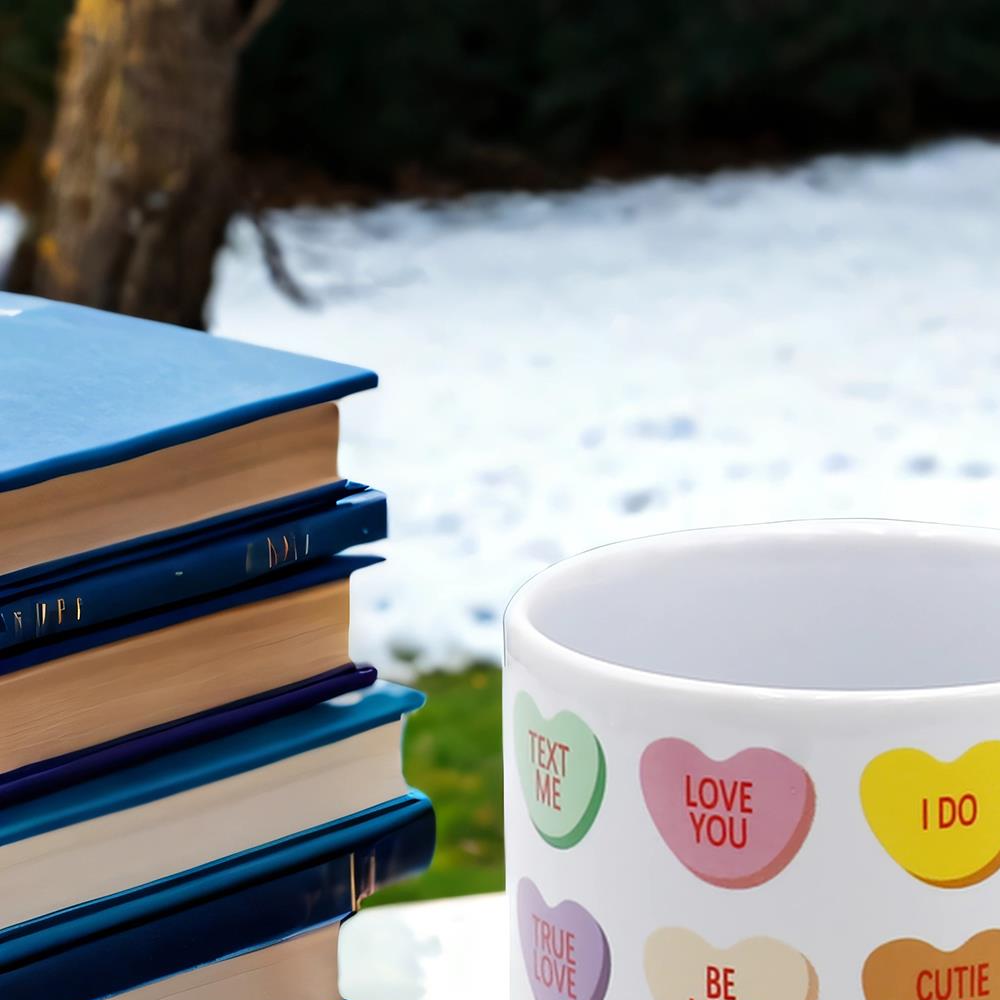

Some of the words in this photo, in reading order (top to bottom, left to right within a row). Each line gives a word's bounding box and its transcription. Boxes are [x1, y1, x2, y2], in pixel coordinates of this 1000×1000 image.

[528, 731, 569, 777] TEXT
[536, 769, 561, 811] ME
[685, 775, 753, 814] LOVE
[690, 812, 748, 849] YOU
[922, 798, 928, 830] I
[938, 793, 977, 829] DO
[532, 914, 576, 966] TRUE
[533, 954, 577, 1000] LOVE
[706, 965, 736, 1000] BE
